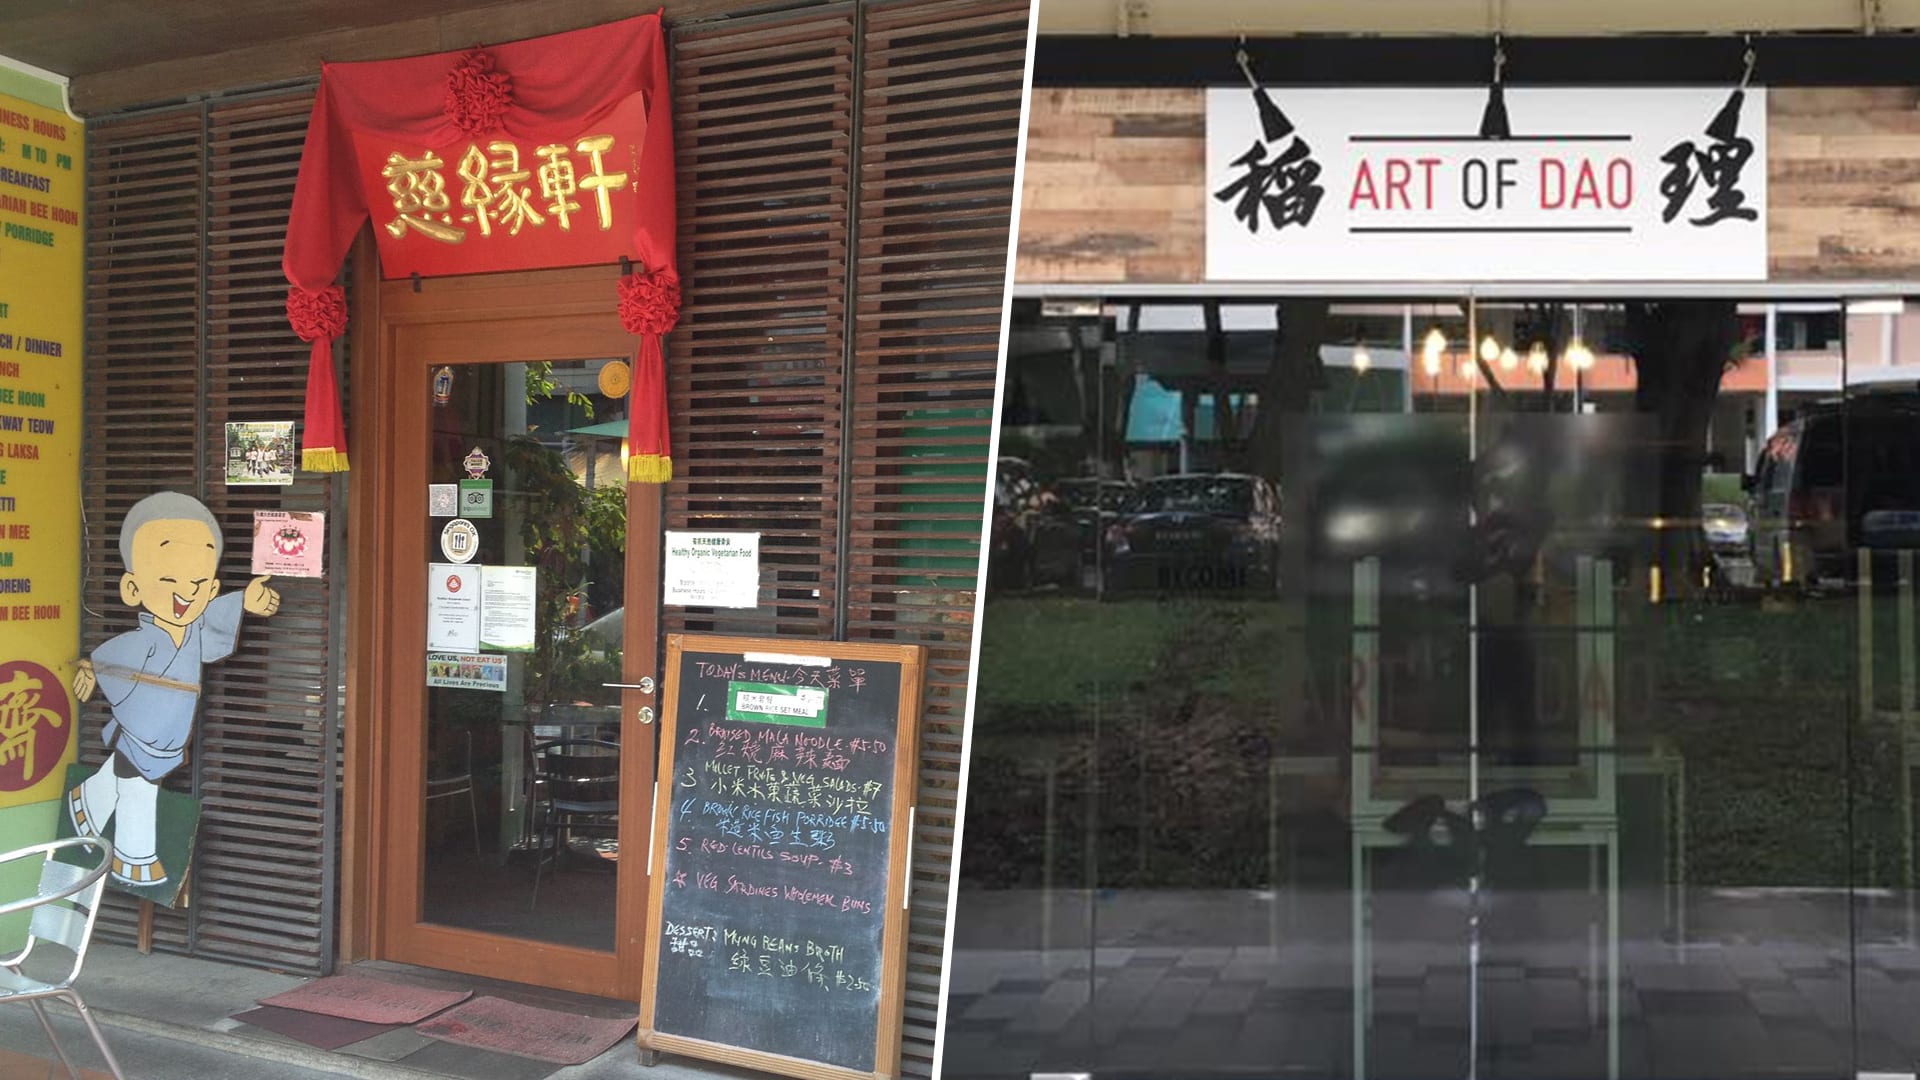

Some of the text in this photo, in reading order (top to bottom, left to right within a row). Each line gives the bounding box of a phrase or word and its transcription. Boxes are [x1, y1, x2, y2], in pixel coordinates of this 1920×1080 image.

[33, 118, 65, 141] HOURS
[35, 146, 47, 164] TO
[56, 153, 71, 171] PM
[0, 167, 50, 193] REAKFAST
[1348, 158, 1633, 210] ART OF DAO
[0, 194, 78, 226] RIAN BEE HOON
[5, 222, 54, 247] PORRIDGE
[25, 338, 62, 357] DINNER
[18, 390, 45, 408] HOON
[28, 418, 54, 435] TEOW
[8, 443, 39, 460] LAKSA
[0, 497, 15, 512] TTI
[9, 525, 30, 539] MEE
[672, 547, 752, 559] Healthy Organic Vegetarian Food
[12, 606, 30, 620] BEE
[34, 605, 60, 619] HOON
[443, 679, 459, 687] Lives
[741, 703, 763, 711] BROWN
[780, 706, 791, 714] SET
[764, 810, 789, 824] FISH
[696, 871, 718, 892] VEG
[841, 896, 871, 914] BUNS
